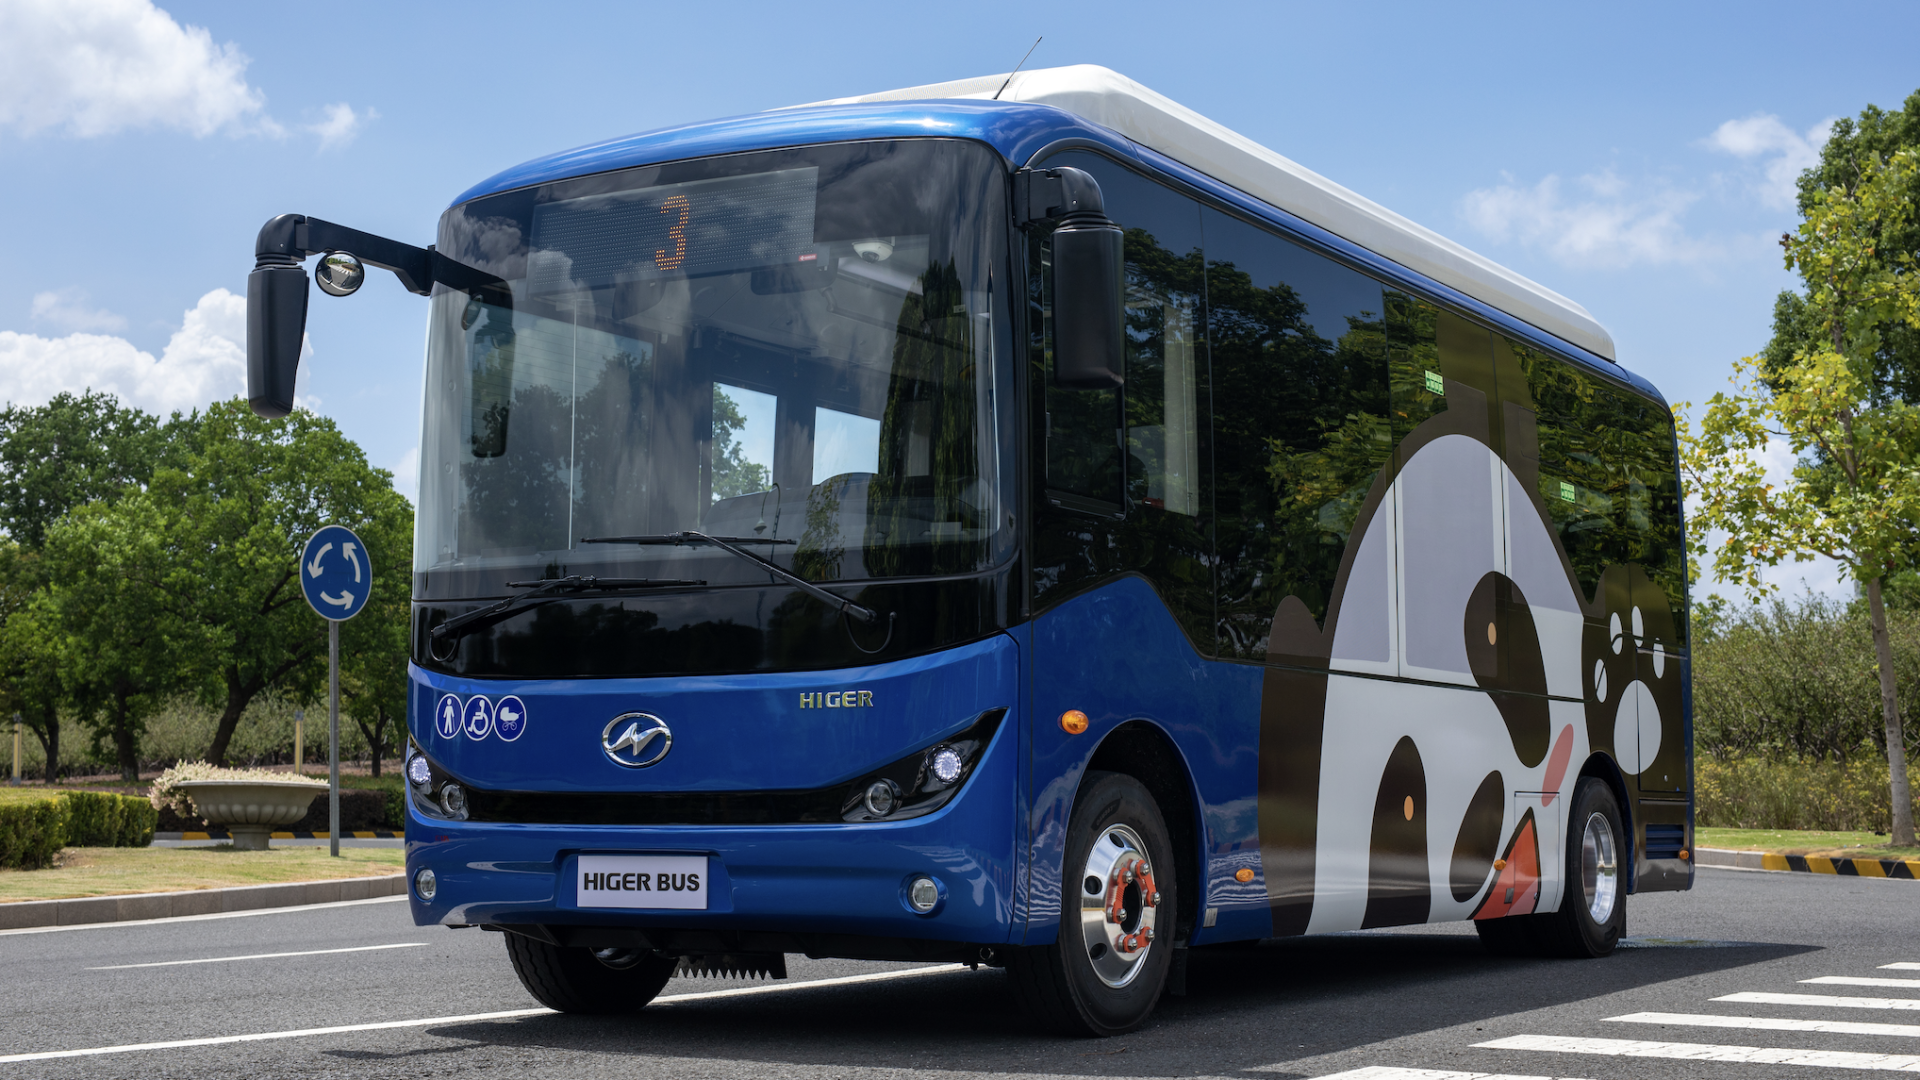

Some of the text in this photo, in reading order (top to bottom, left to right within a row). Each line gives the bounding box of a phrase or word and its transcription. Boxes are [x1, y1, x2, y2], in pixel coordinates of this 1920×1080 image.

[655, 195, 690, 270] 3
[799, 690, 874, 709] HIGER
[583, 872, 700, 892] HIGER BUS
